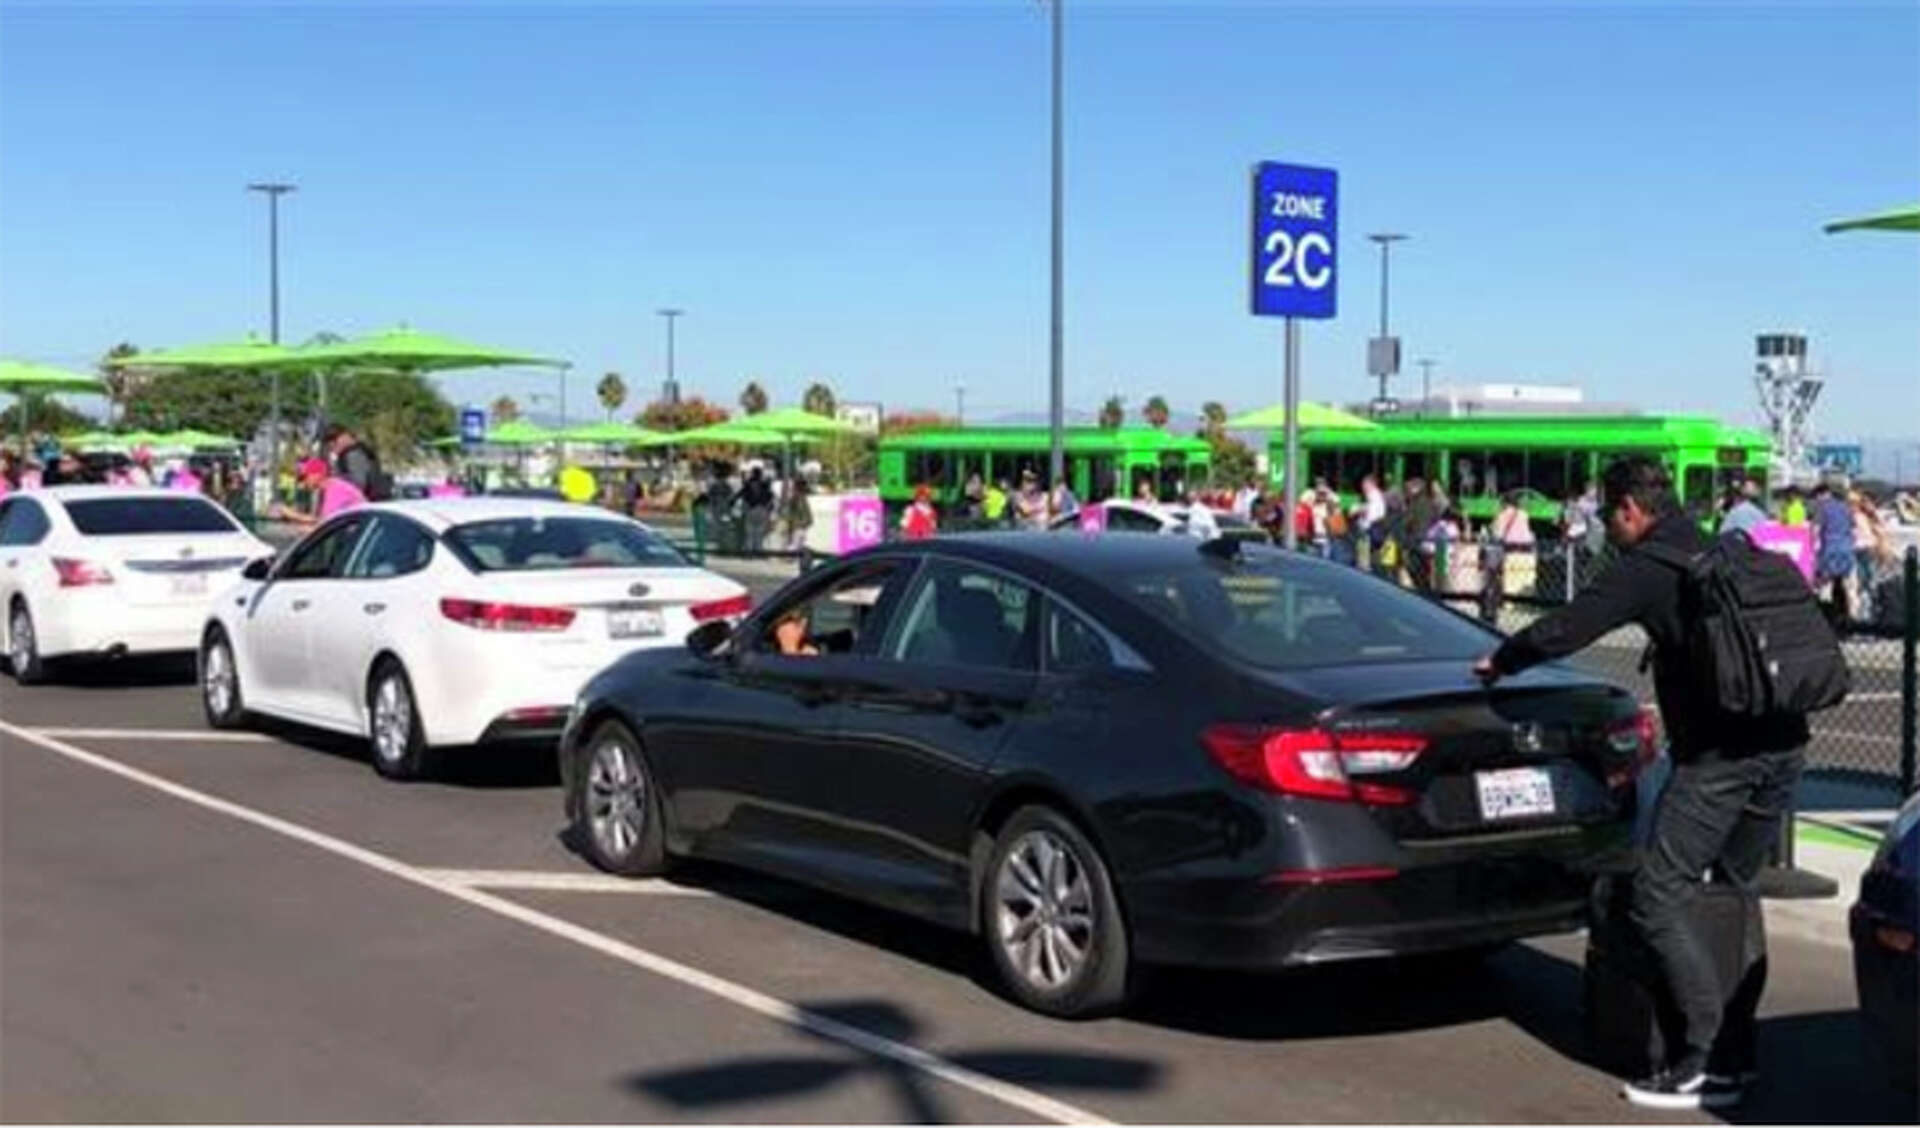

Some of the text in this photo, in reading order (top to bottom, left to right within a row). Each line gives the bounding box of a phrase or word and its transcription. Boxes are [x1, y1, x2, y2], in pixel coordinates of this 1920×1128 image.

[1271, 192, 1325, 220] ZONE
[1264, 230, 1331, 290] 2C
[845, 509, 878, 541] 16
